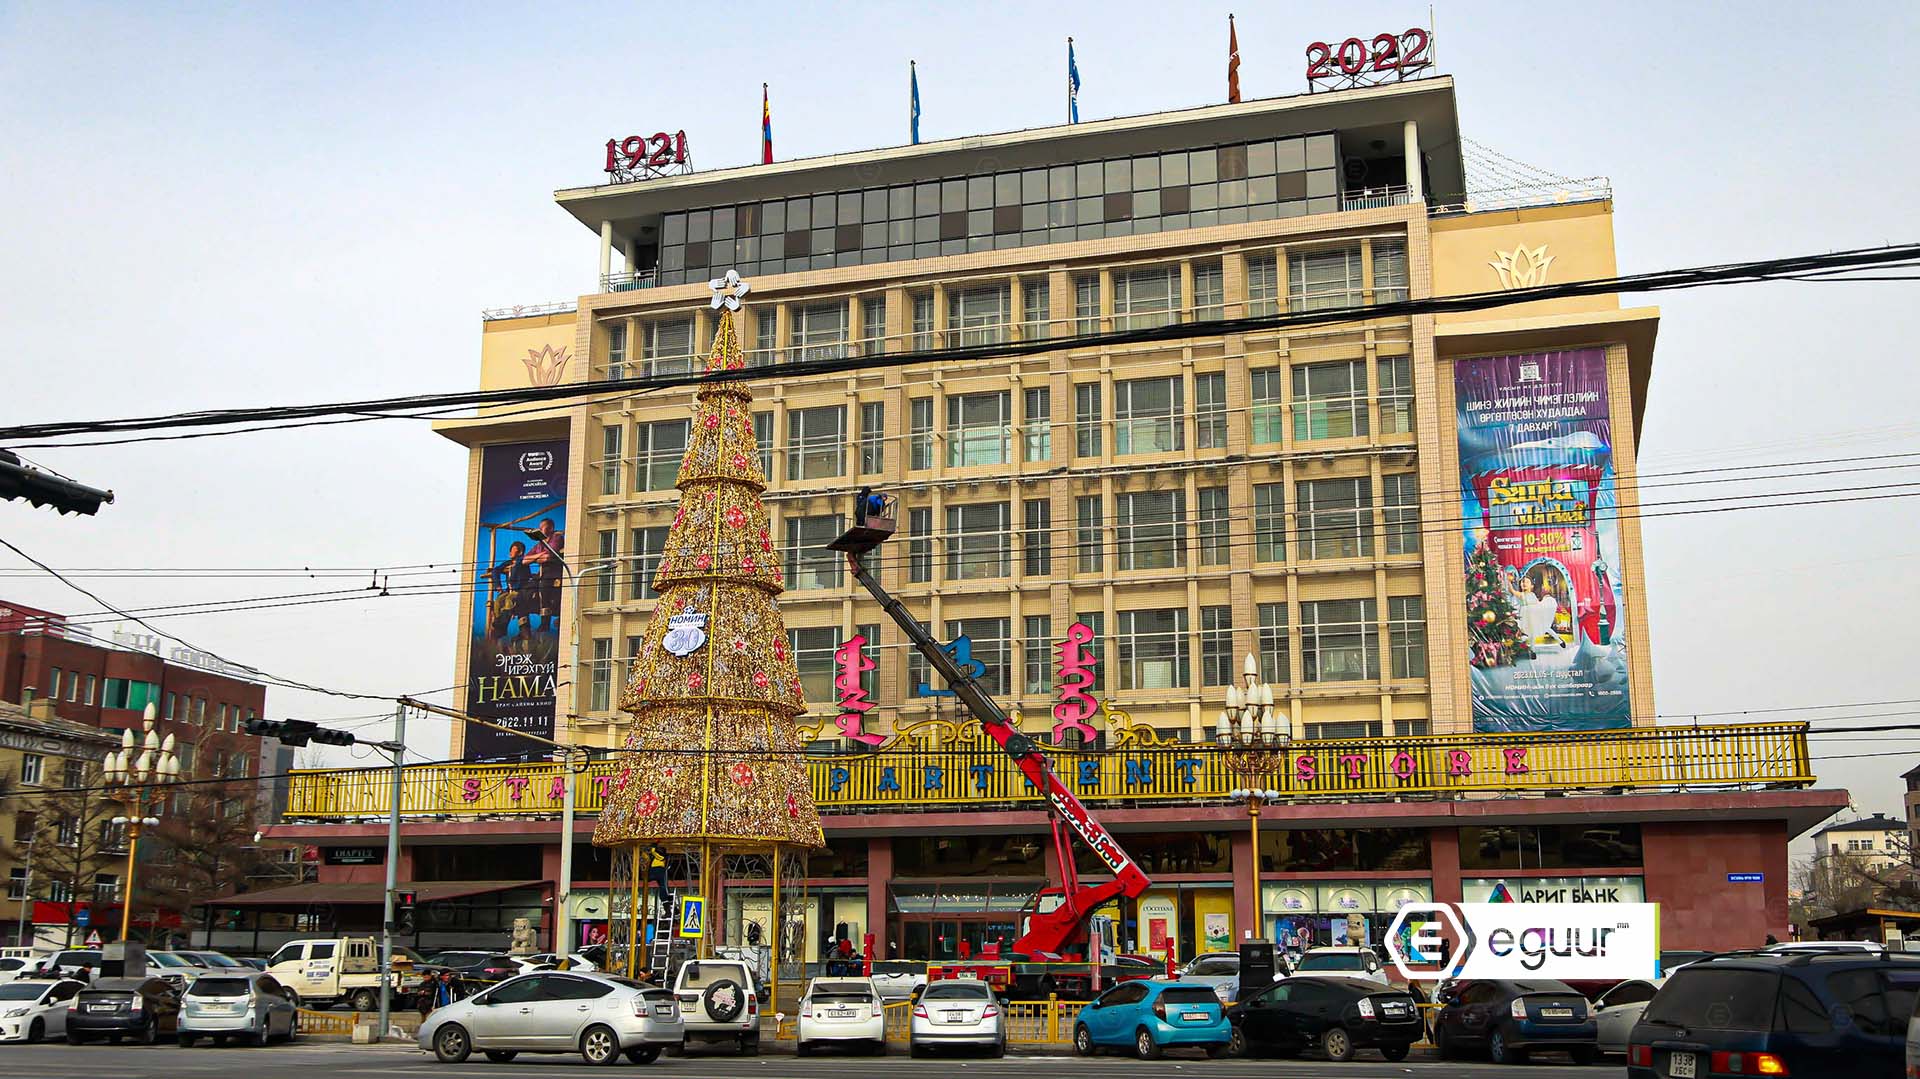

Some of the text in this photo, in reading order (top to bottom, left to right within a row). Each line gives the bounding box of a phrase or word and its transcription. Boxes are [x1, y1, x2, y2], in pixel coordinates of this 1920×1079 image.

[1306, 28, 1429, 79] 2022
[604, 130, 685, 172] 1921
[1467, 391, 1599, 411] ШИНЭ ЖИЛИЙН ЧИМЭГЛЭЛИЙН
[1536, 406, 1587, 418] ХУДАЛДАА
[1517, 420, 1558, 433] ДАВХАРТ
[1491, 476, 1574, 506] Santa
[1524, 531, 1565, 546] 10-30%
[670, 615, 705, 624] НОМИН
[496, 653, 533, 673] ЭРГЭЖ
[508, 661, 555, 675] ИРЭХГҮЙ
[463, 748, 1529, 802] STAT PARTENT STORE
[1522, 888, 1620, 903] АРИГ БАНК
